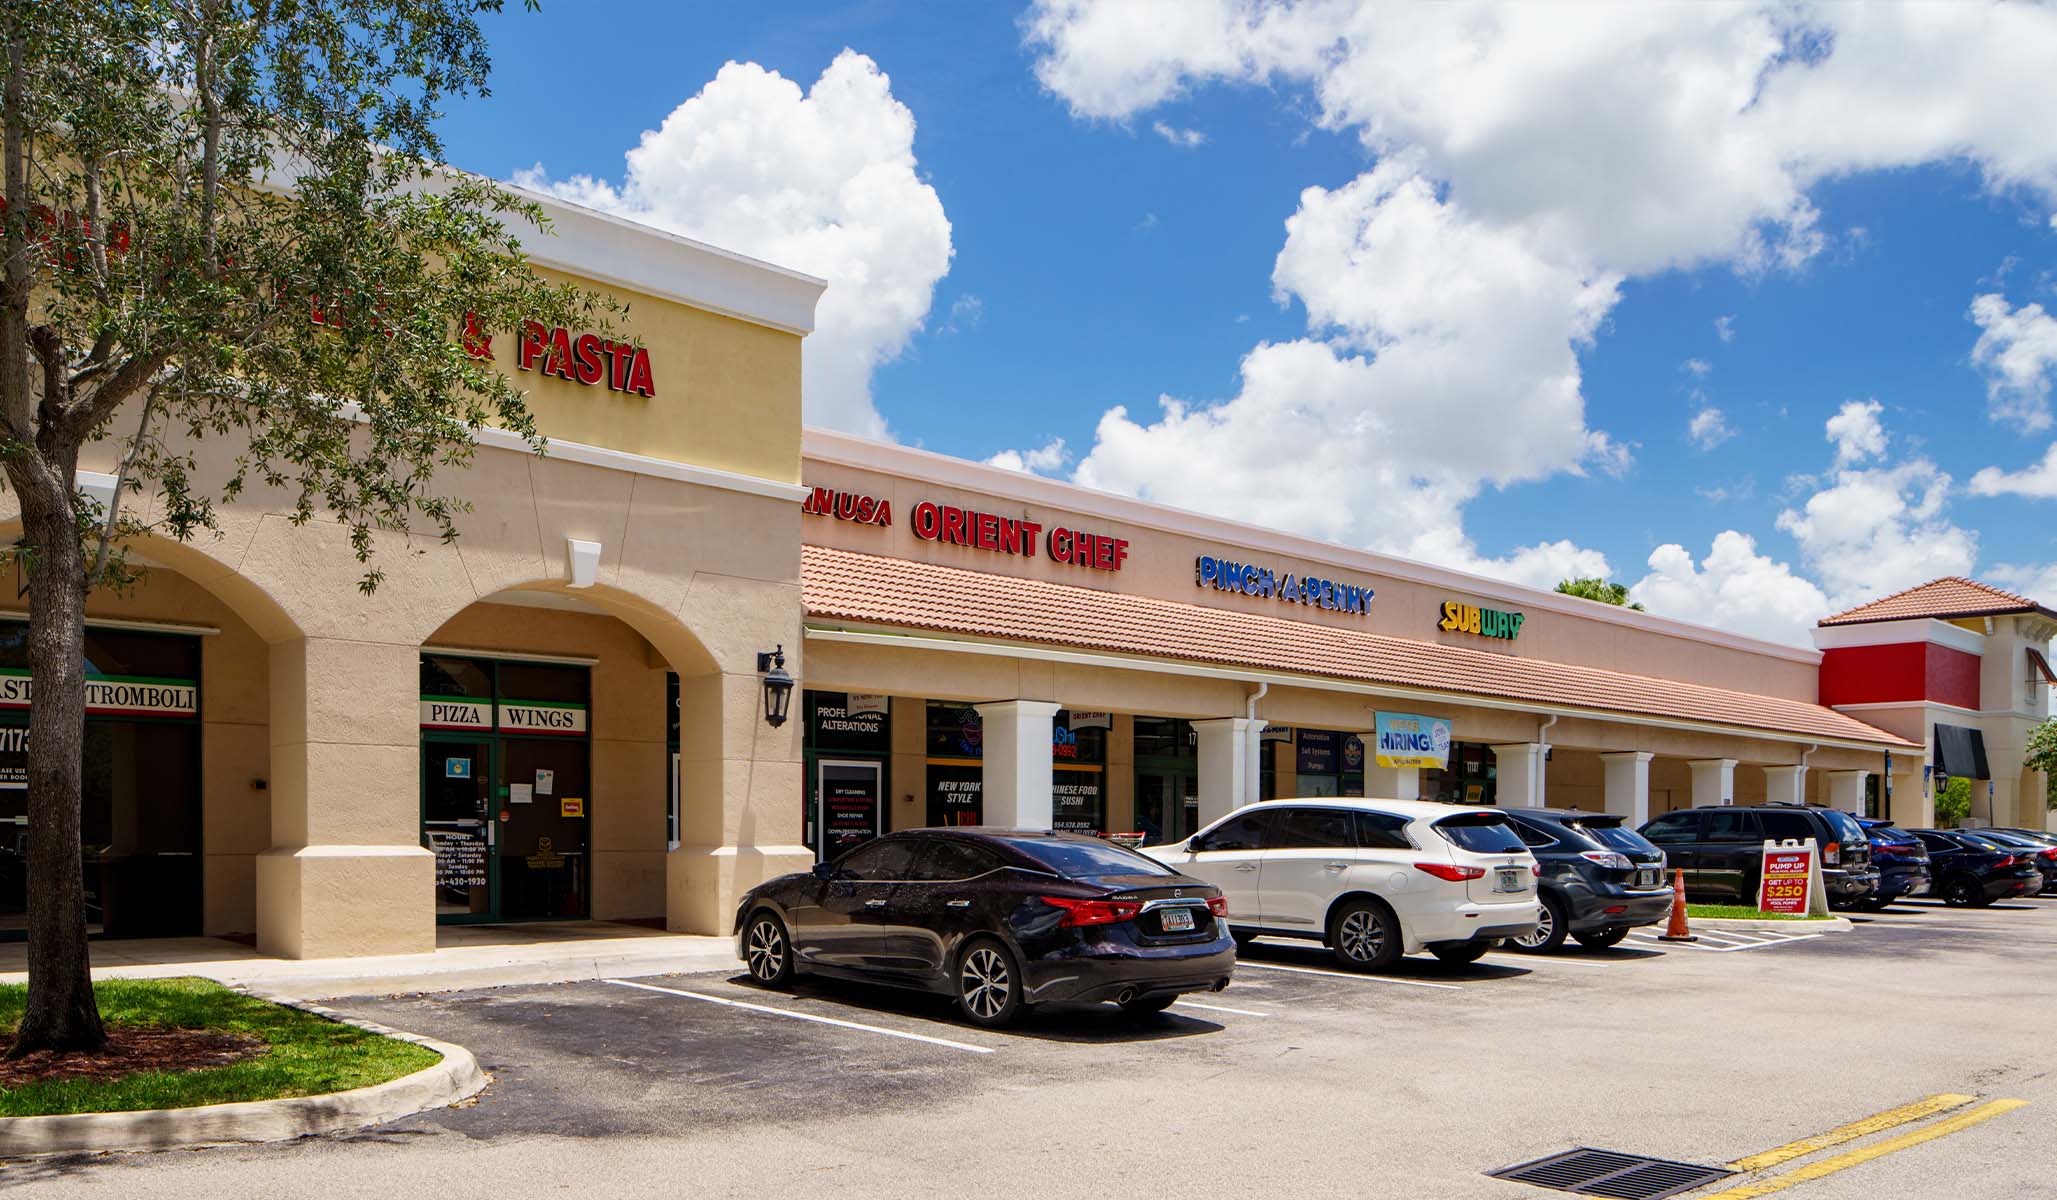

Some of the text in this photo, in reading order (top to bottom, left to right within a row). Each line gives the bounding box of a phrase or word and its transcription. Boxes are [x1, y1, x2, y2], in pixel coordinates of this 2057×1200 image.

[462, 311, 656, 398] & PASTA
[836, 491, 892, 527] USA
[912, 501, 1129, 571] ORIENT CHEF
[1438, 600, 1525, 640] SUBWAY
[0, 678, 32, 700] ST
[431, 704, 481, 724] PIZZA
[508, 708, 574, 729] WINGS
[821, 719, 879, 733] ALTERATIONS
[1381, 731, 1435, 752] HIRING!
[938, 781, 981, 792] NEW YORK
[1079, 785, 1098, 795] FOOD
[947, 793, 973, 803] STYLE
[1060, 796, 1084, 806] SUSHI
[1767, 885, 1803, 897] $250
